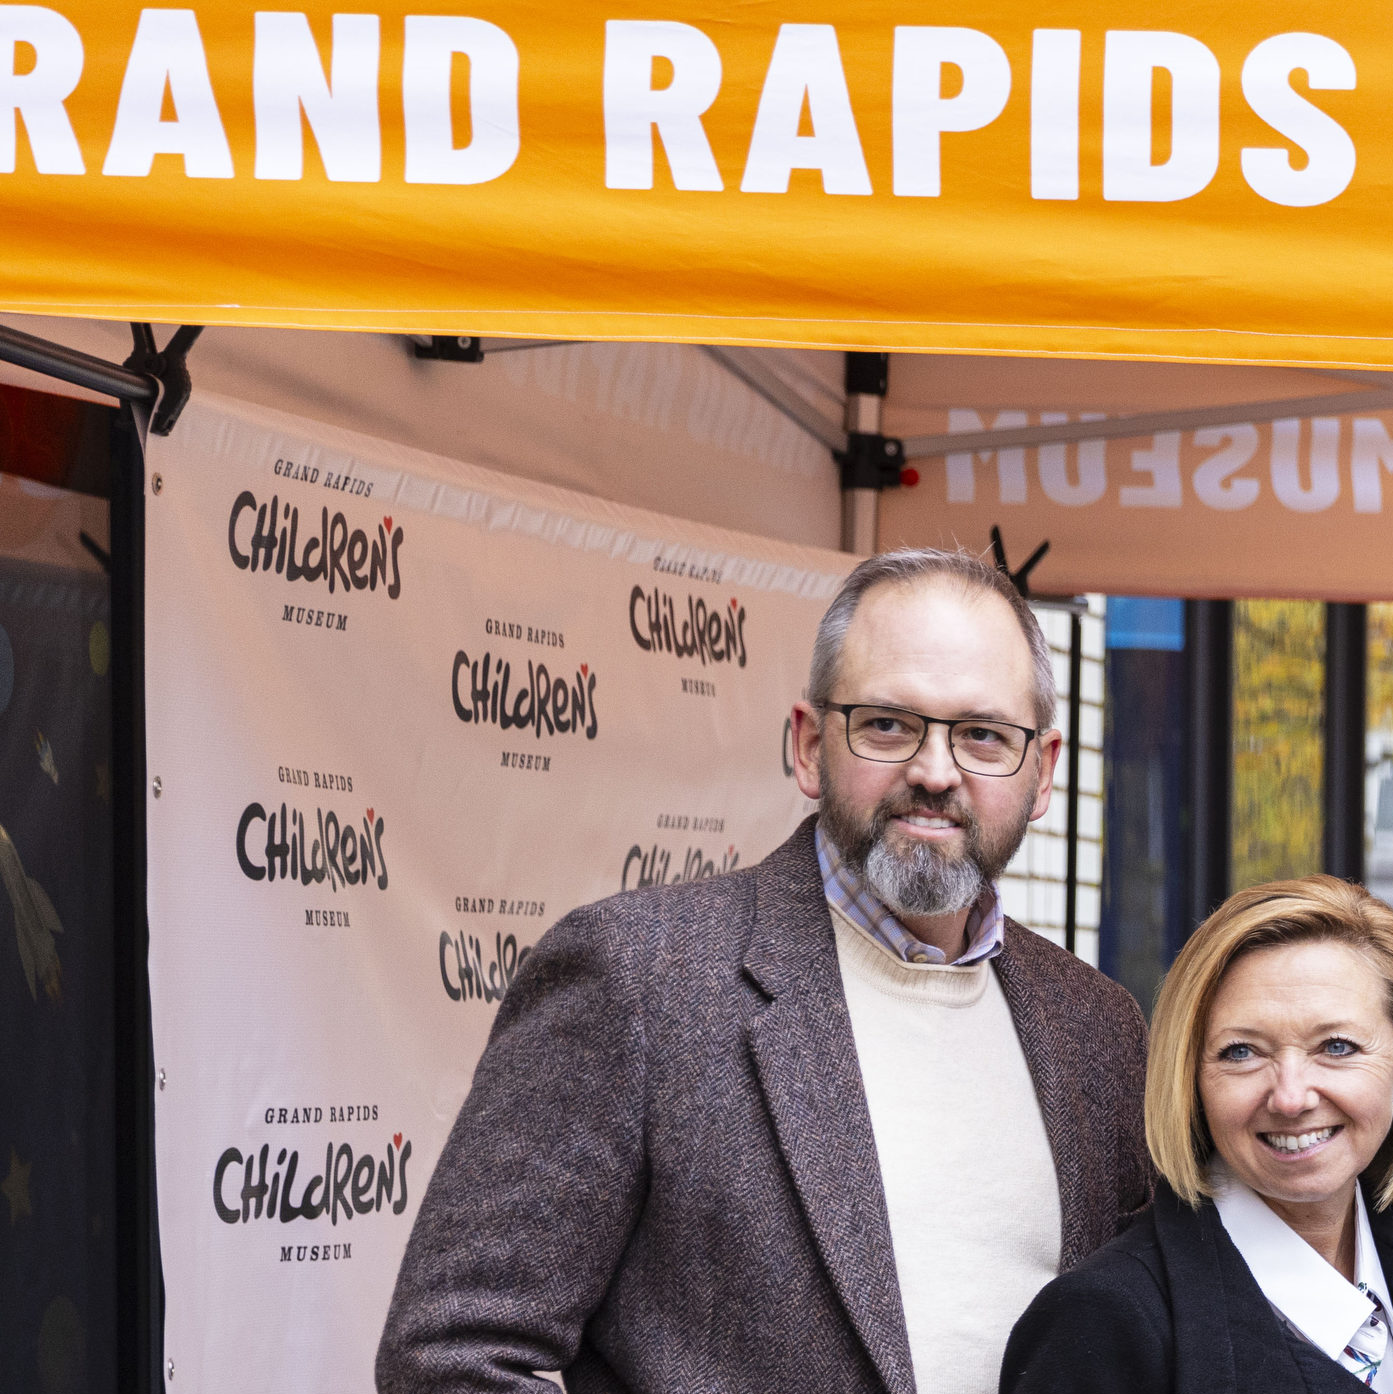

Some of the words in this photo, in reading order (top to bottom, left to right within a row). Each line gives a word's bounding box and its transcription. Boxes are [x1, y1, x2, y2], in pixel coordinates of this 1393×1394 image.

[0, 4, 519, 184] RAND
[605, 19, 1357, 207] RAPIDS
[274, 458, 319, 484] GRAND
[324, 472, 374, 498] RAPIDS
[282, 605, 348, 631] MUSEUM
[485, 618, 523, 640] GRAND
[527, 627, 565, 649] RAPIDS
[500, 751, 551, 772] MUSEUM
[278, 766, 310, 787] GRAND
[314, 772, 353, 793] RAPIDS
[305, 909, 351, 928] MUSEUM
[455, 896, 495, 914] GRAND
[499, 898, 546, 918] RAPIDS
[265, 1107, 323, 1124] GRAND
[330, 1105, 379, 1123] RAPIDS
[280, 1243, 352, 1262] MUSEUM
